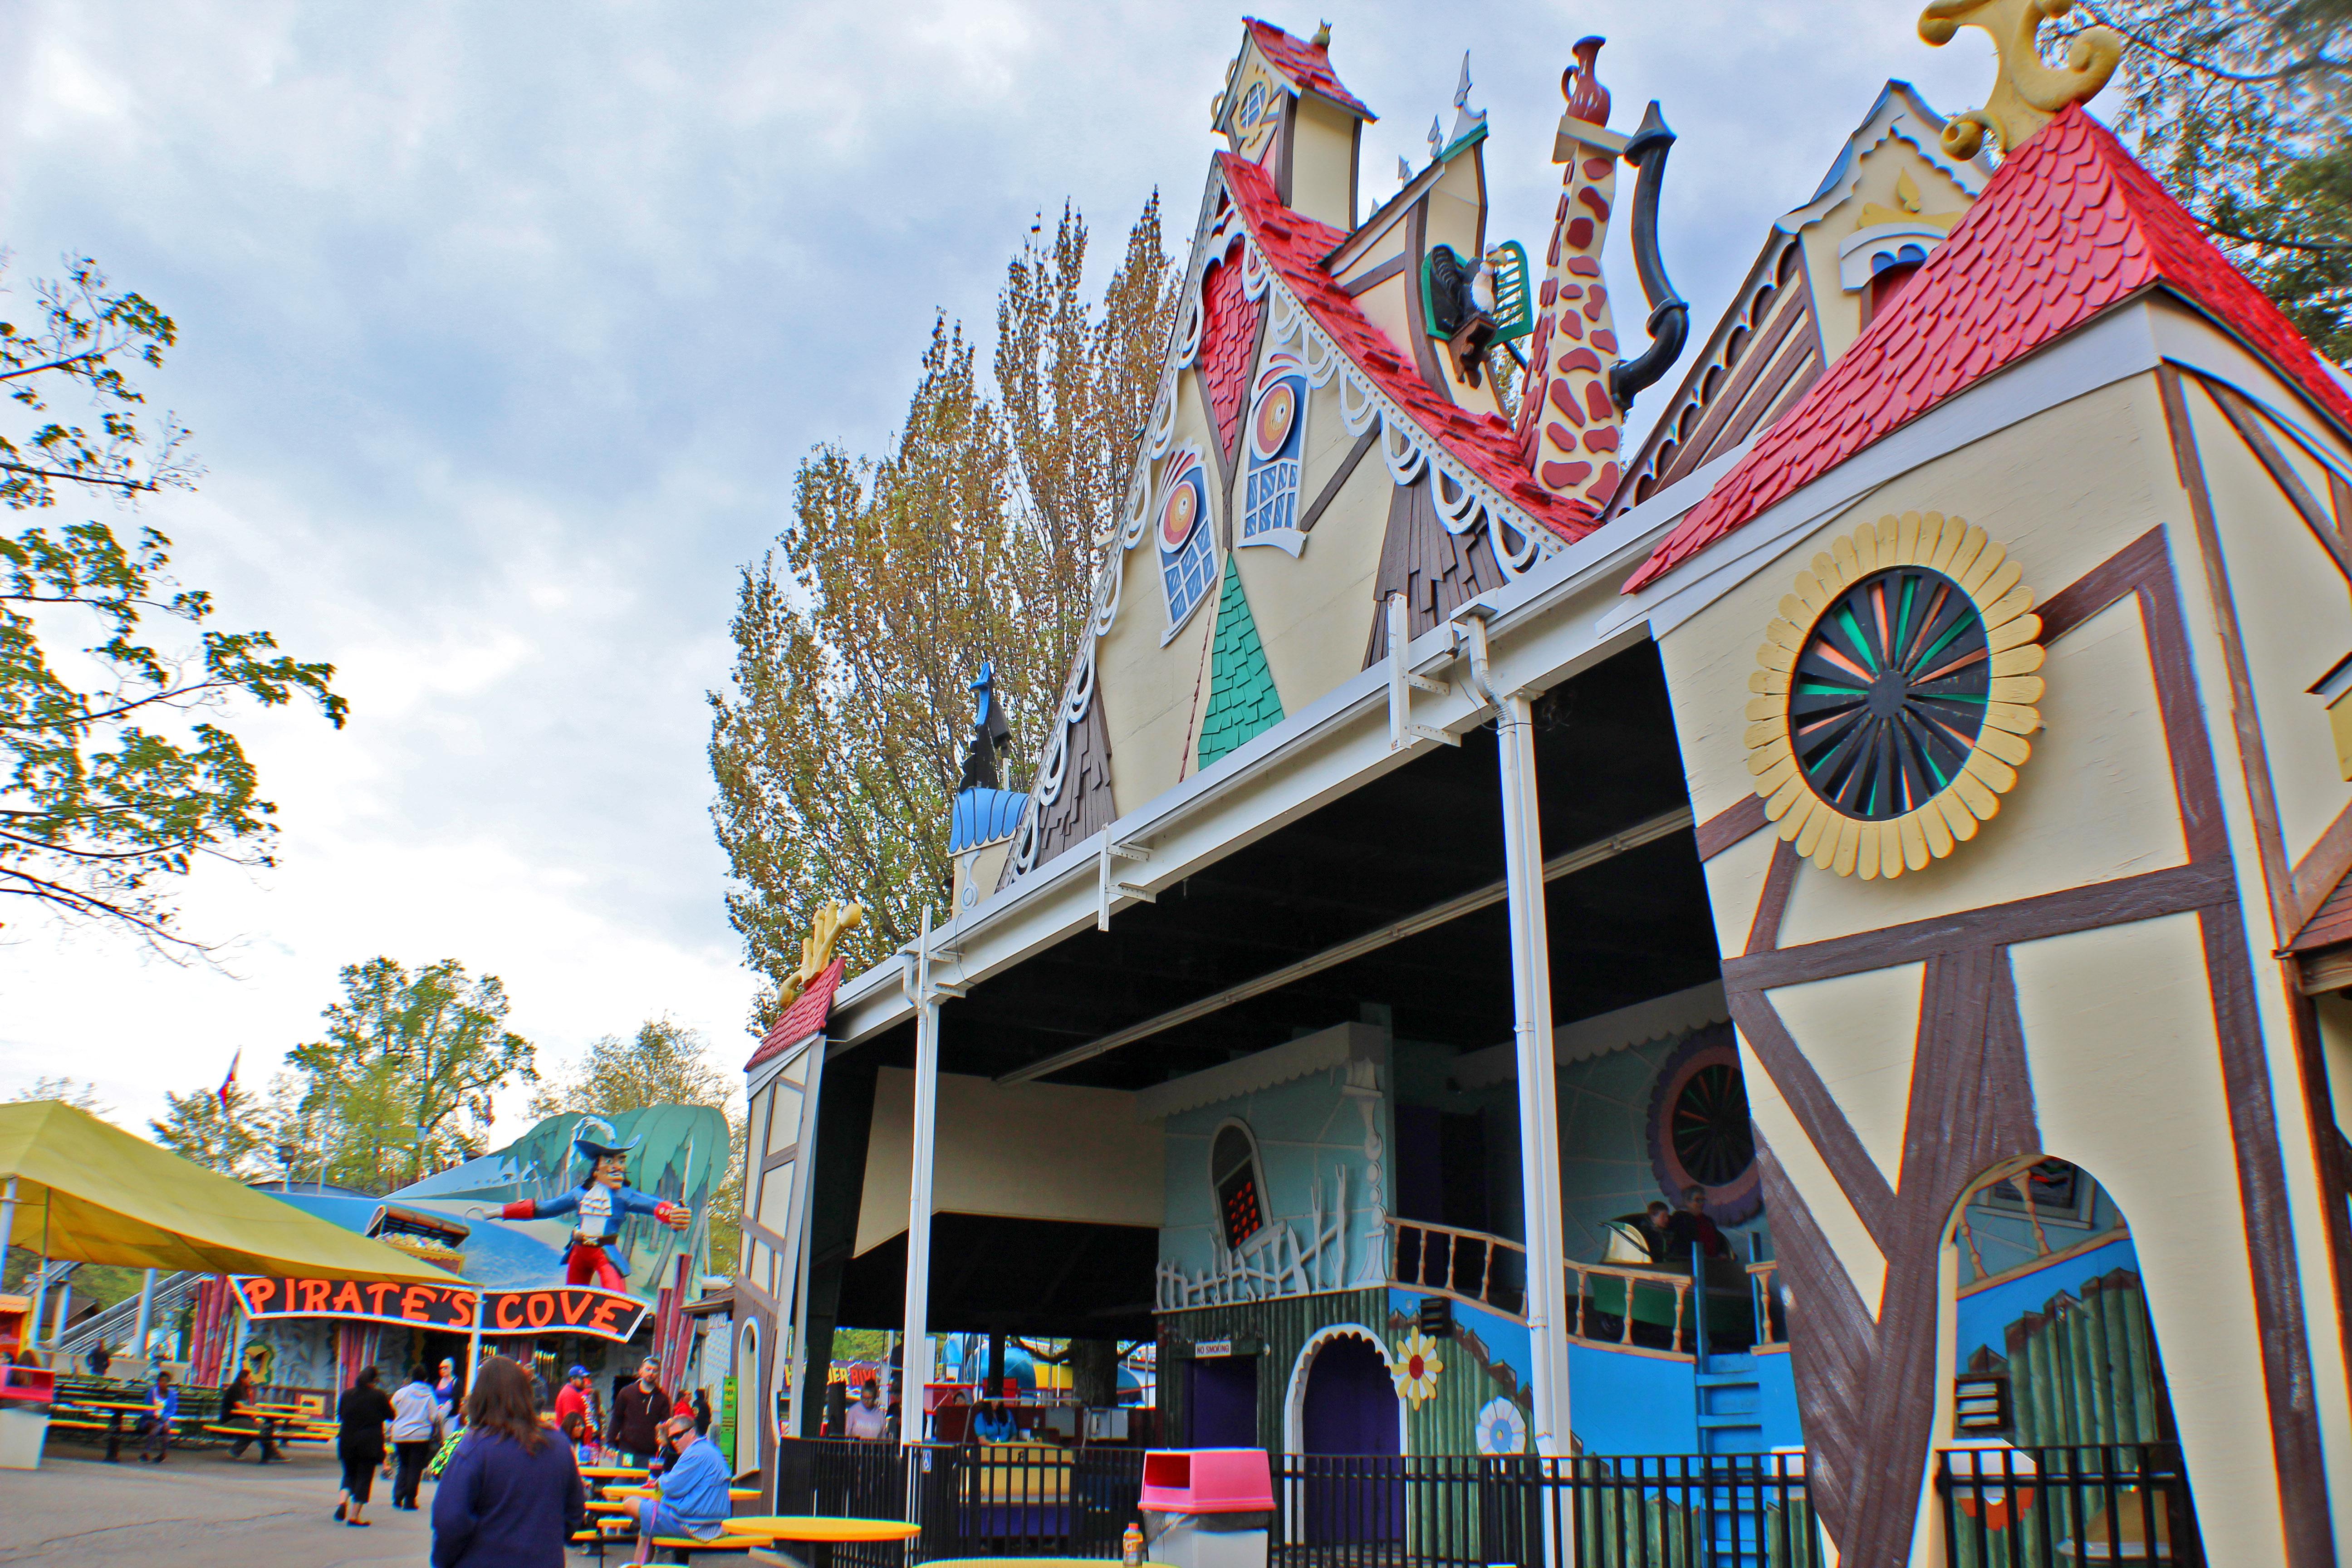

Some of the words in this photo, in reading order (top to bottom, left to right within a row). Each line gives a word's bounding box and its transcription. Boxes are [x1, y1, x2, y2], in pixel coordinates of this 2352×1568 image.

[242, 1278, 478, 1327] PIRATE'S
[496, 1291, 635, 1334] COVE
[1197, 1346, 1205, 1354] NO
[1206, 1344, 1230, 1353] SMOKING
